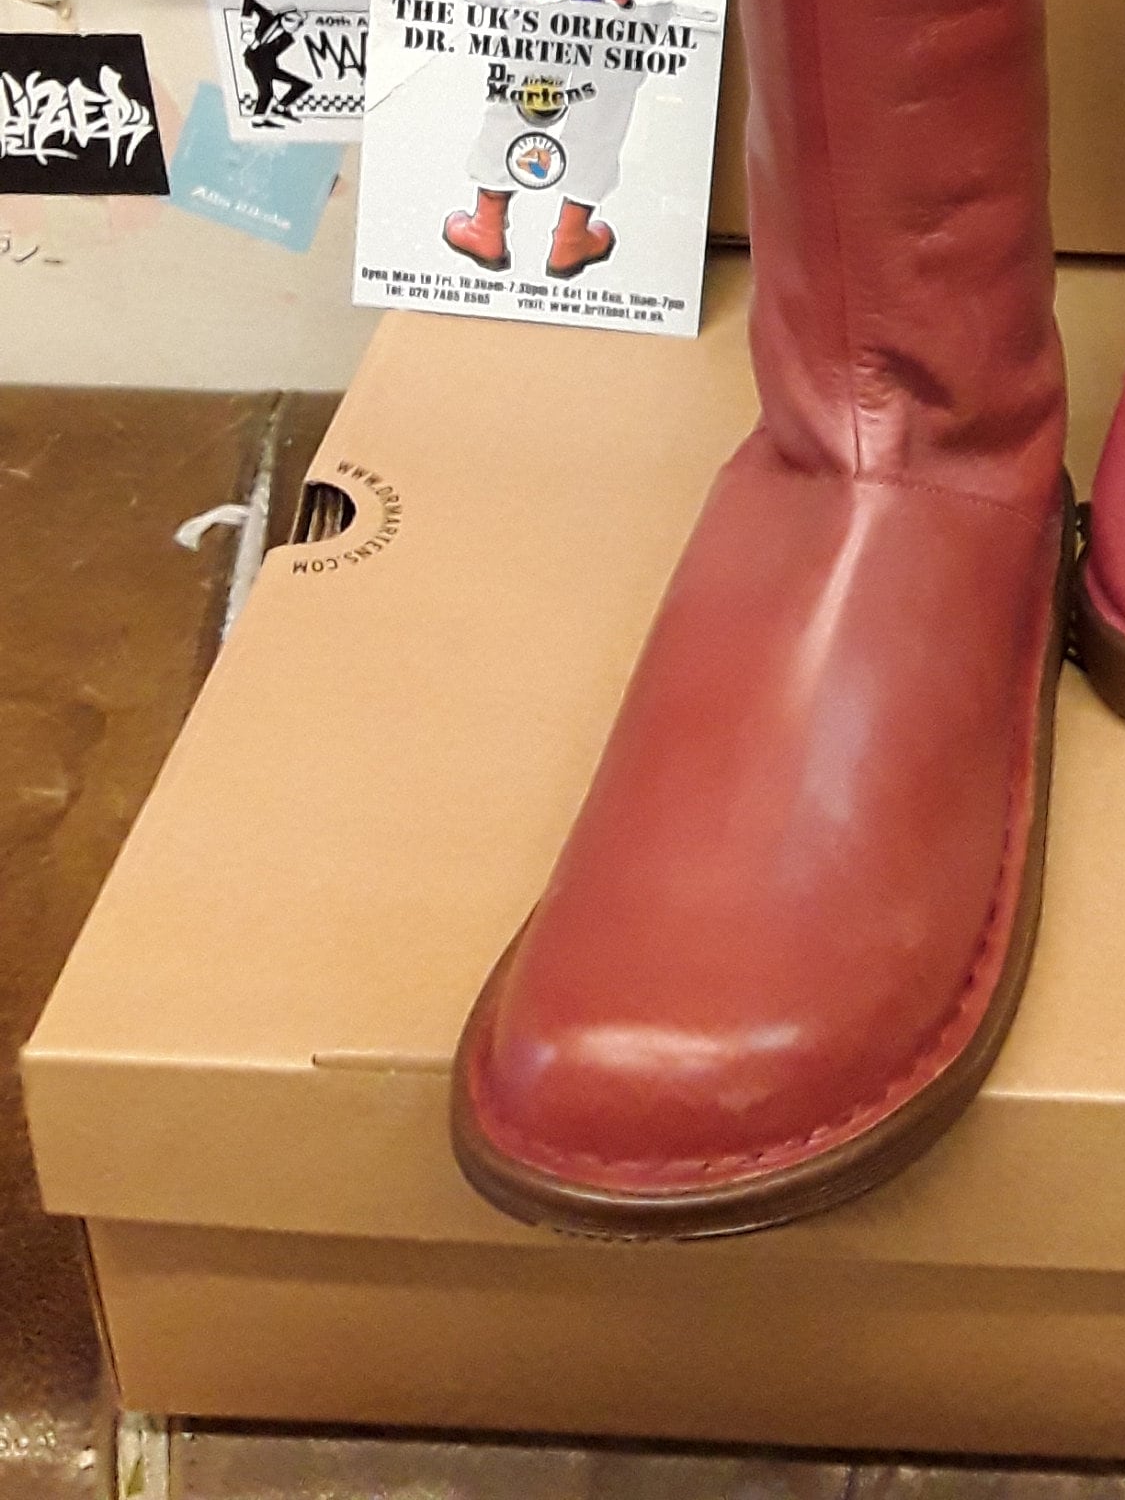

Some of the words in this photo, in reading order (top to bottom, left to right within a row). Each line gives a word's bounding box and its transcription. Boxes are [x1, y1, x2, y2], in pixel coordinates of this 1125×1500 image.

[467, 3, 540, 33] UK'S
[549, 12, 698, 50] ORIGINAL
[404, 26, 456, 53] DR.
[468, 32, 594, 67] MARTEN
[603, 47, 688, 76] SHOP
[486, 80, 597, 104] Martens
[361, 267, 388, 281] Open
[392, 270, 416, 284] Mon
